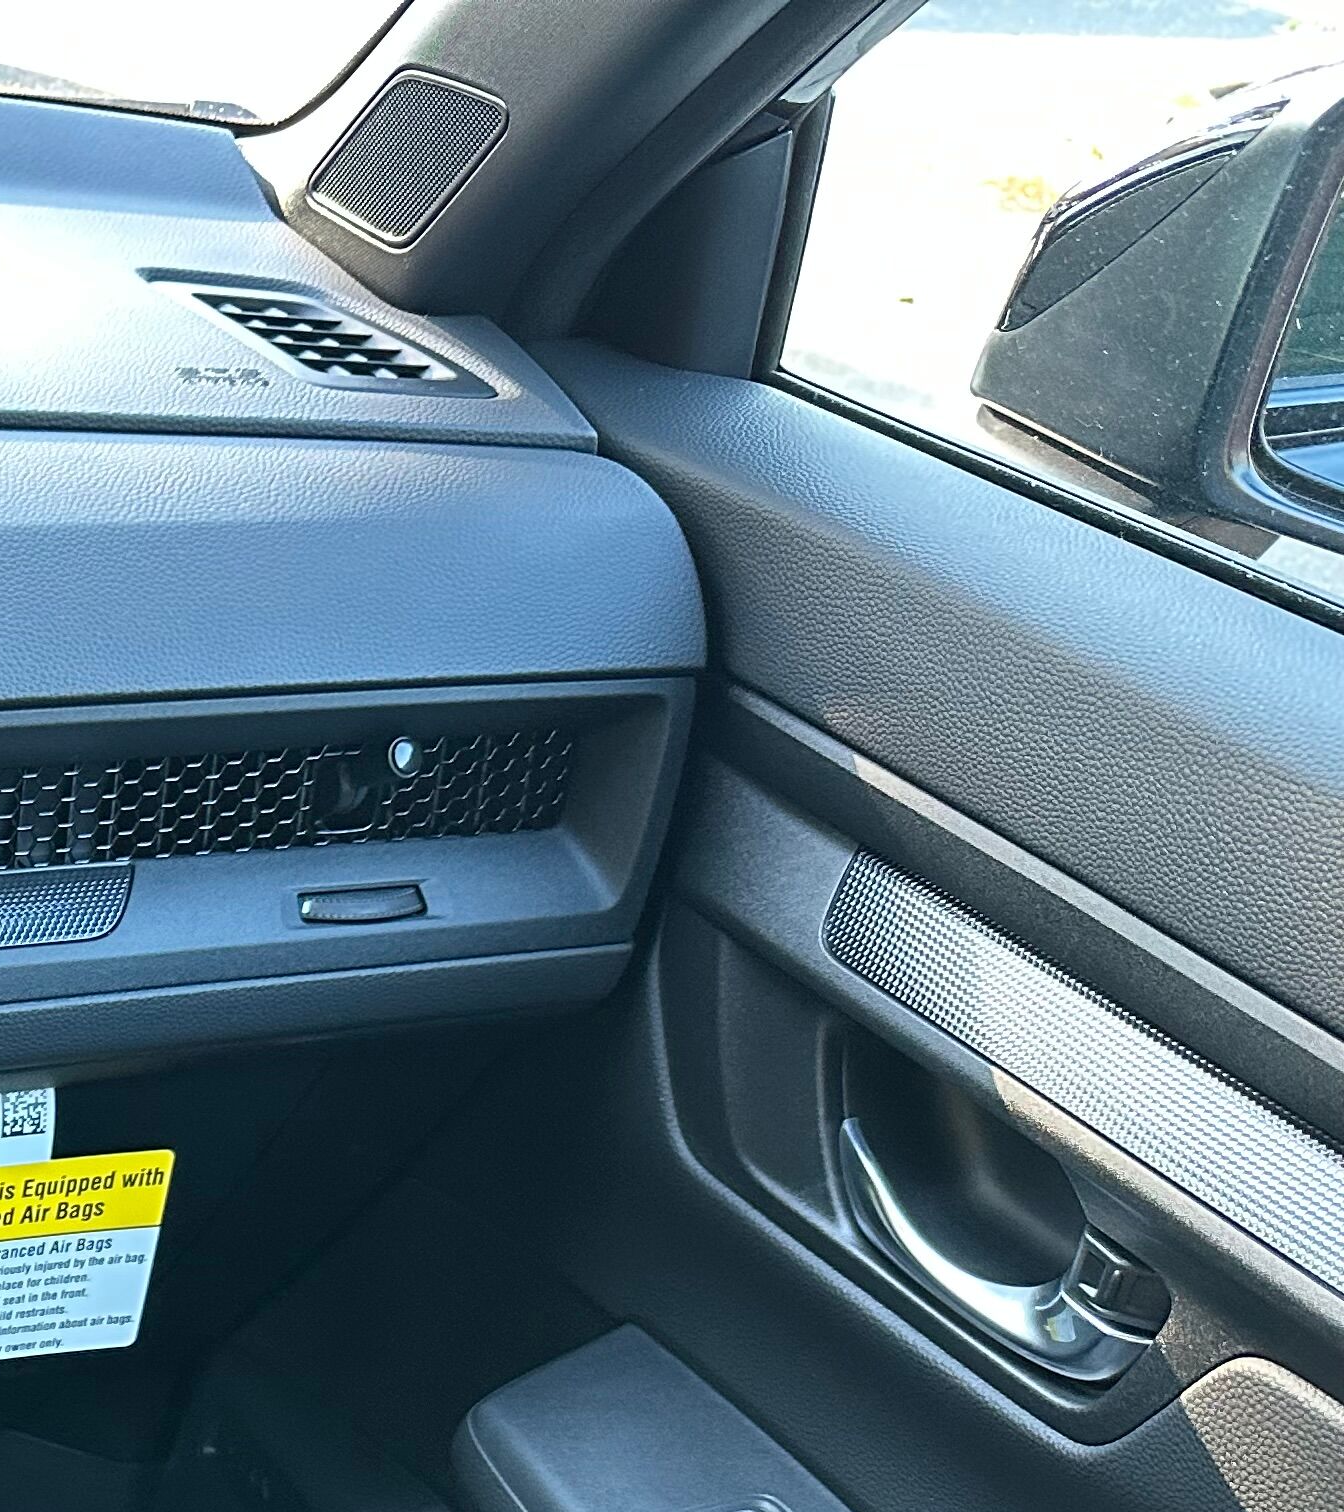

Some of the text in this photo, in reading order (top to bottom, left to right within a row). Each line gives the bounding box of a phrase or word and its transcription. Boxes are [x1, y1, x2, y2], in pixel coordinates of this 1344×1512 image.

[21, 1170, 116, 1201] Equipped
[121, 1167, 164, 1189] with
[20, 1203, 49, 1226] Air
[56, 1200, 105, 1222] Bags
[49, 1240, 73, 1254] Air
[75, 1238, 113, 1252] Bags
[34, 1259, 70, 1275] injured
[73, 1258, 86, 1269] by
[88, 1257, 105, 1267] the
[107, 1255, 122, 1265] air
[125, 1253, 147, 1265] bag.
[27, 1276, 42, 1287] for
[44, 1273, 91, 1286] children.
[2, 1293, 25, 1305] seat
[28, 1292, 38, 1303] in
[41, 1290, 57, 1302] the
[15, 1305, 67, 1320] restraints.
[58, 1317, 88, 1329] about
[90, 1315, 105, 1326] air
[4, 1341, 37, 1352] owner
